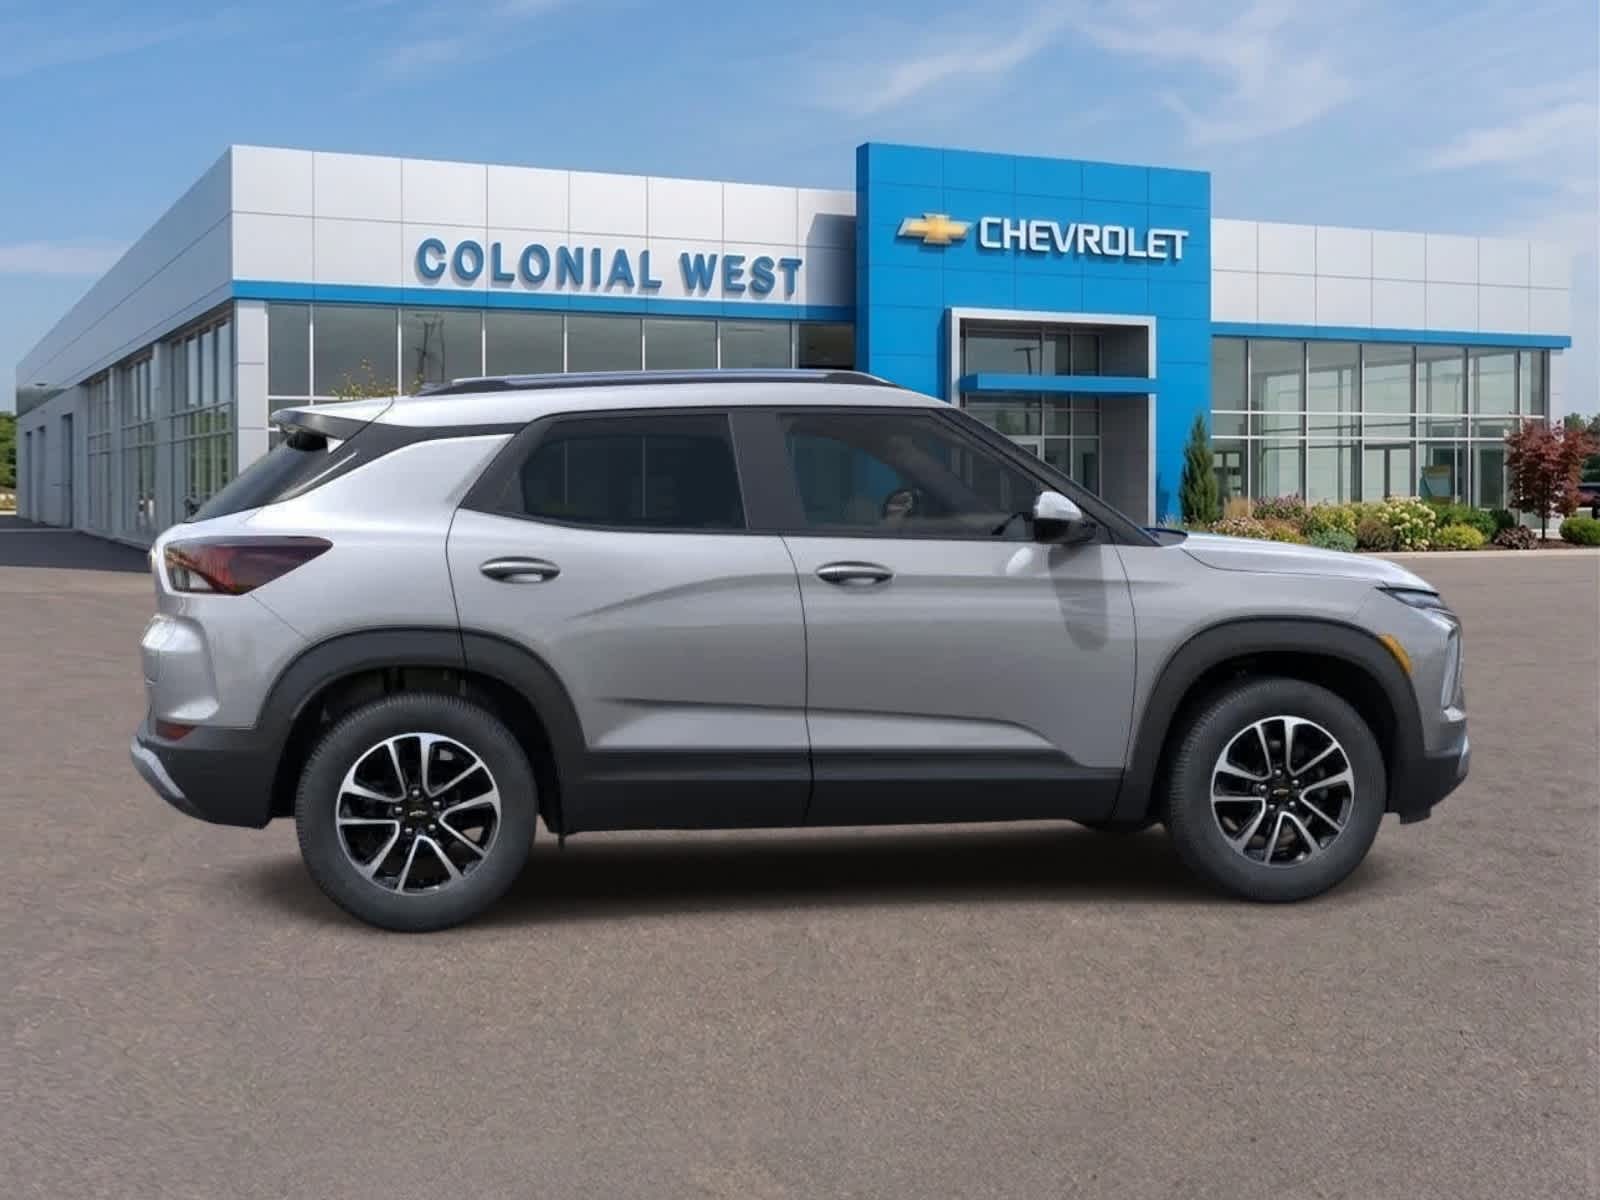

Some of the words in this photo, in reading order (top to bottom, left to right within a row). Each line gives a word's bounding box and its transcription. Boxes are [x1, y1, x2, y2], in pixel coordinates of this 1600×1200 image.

[979, 216, 1189, 261] CHEVROLET
[416, 238, 662, 289] COLONIAL
[680, 252, 803, 296] WEST
